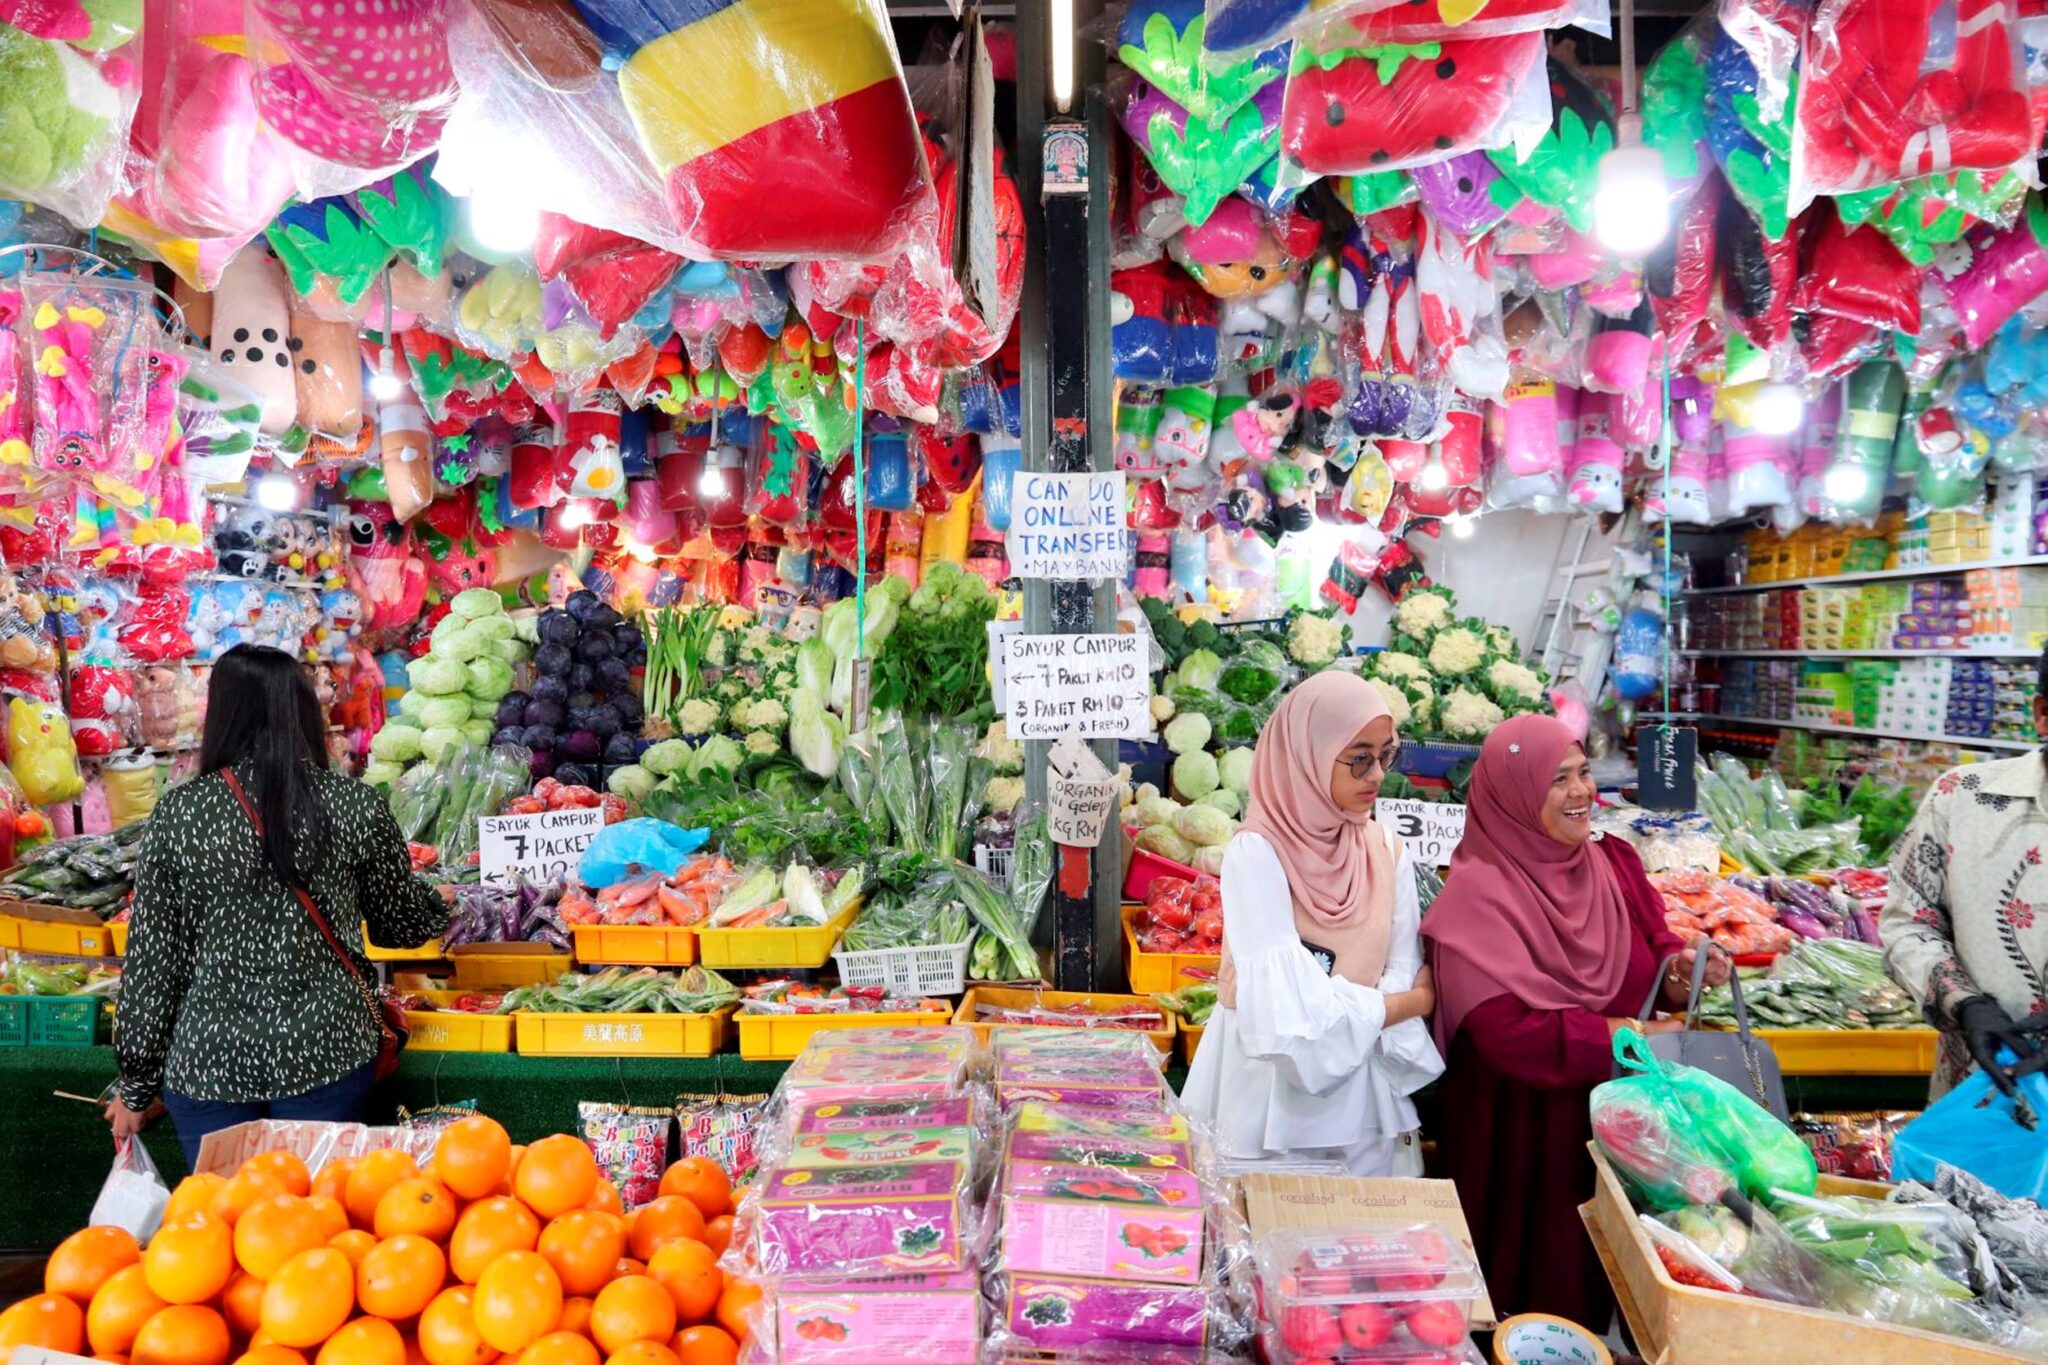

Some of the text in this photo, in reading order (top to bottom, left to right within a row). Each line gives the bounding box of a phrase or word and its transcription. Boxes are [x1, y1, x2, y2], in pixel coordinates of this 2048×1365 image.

[1027, 477, 1071, 501] CAN
[1024, 505, 1116, 527] ONLNE
[1019, 529, 1126, 555] TRANSFER
[1013, 636, 1137, 658] SAYUR CAMPUR
[1037, 664, 1054, 688] 7
[1015, 701, 1028, 718] 3
[1381, 800, 1466, 817] SAYUR CAM
[485, 812, 599, 833] SAYUR CAMPUR
[1053, 817, 1072, 840] KG
[1396, 814, 1424, 837] 3
[504, 833, 595, 860] 7 PACKET
[1280, 1193, 1335, 1205] cocoaland
[1351, 1195, 1407, 1206] cocoaland
